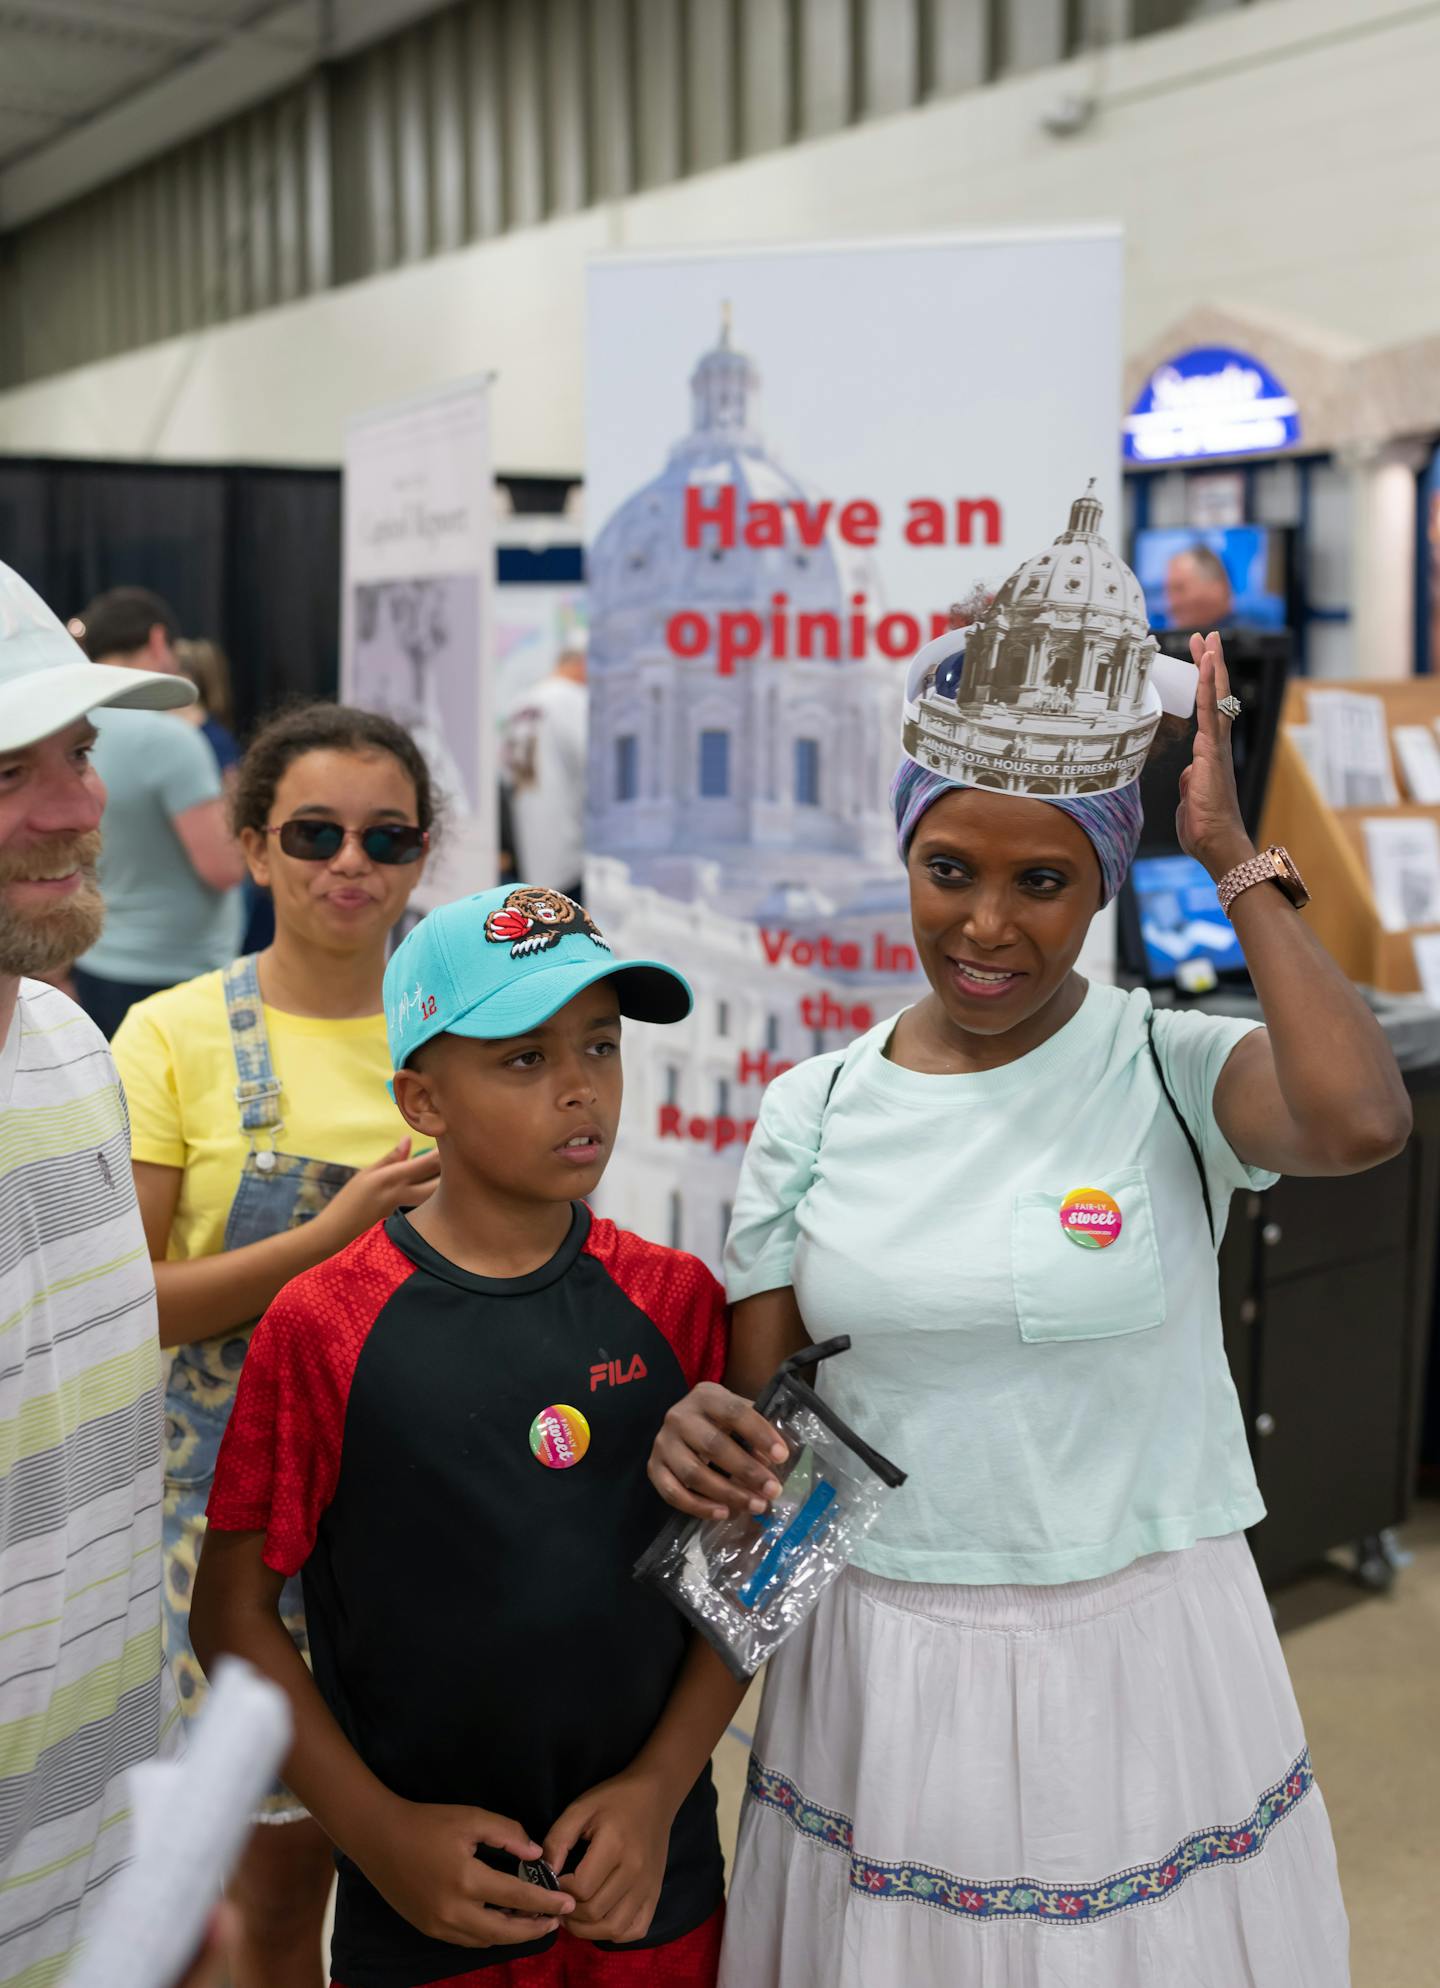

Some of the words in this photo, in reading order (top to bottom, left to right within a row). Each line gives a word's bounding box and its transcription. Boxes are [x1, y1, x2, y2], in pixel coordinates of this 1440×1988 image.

[683, 485, 880, 549] Have
[904, 497, 1003, 545] an
[918, 736, 989, 767] MINNESOTA
[993, 757, 1039, 774] HOUSE
[1041, 764, 1060, 775] OF
[1062, 750, 1146, 775] REPRESENTA
[760, 928, 860, 971] Vote
[873, 933, 916, 972] in
[421, 995, 438, 1021] 12
[799, 991, 874, 1032] the
[1068, 1210, 1117, 1226] sweet
[590, 1354, 648, 1392] FILA
[544, 1416, 575, 1462] sweet
